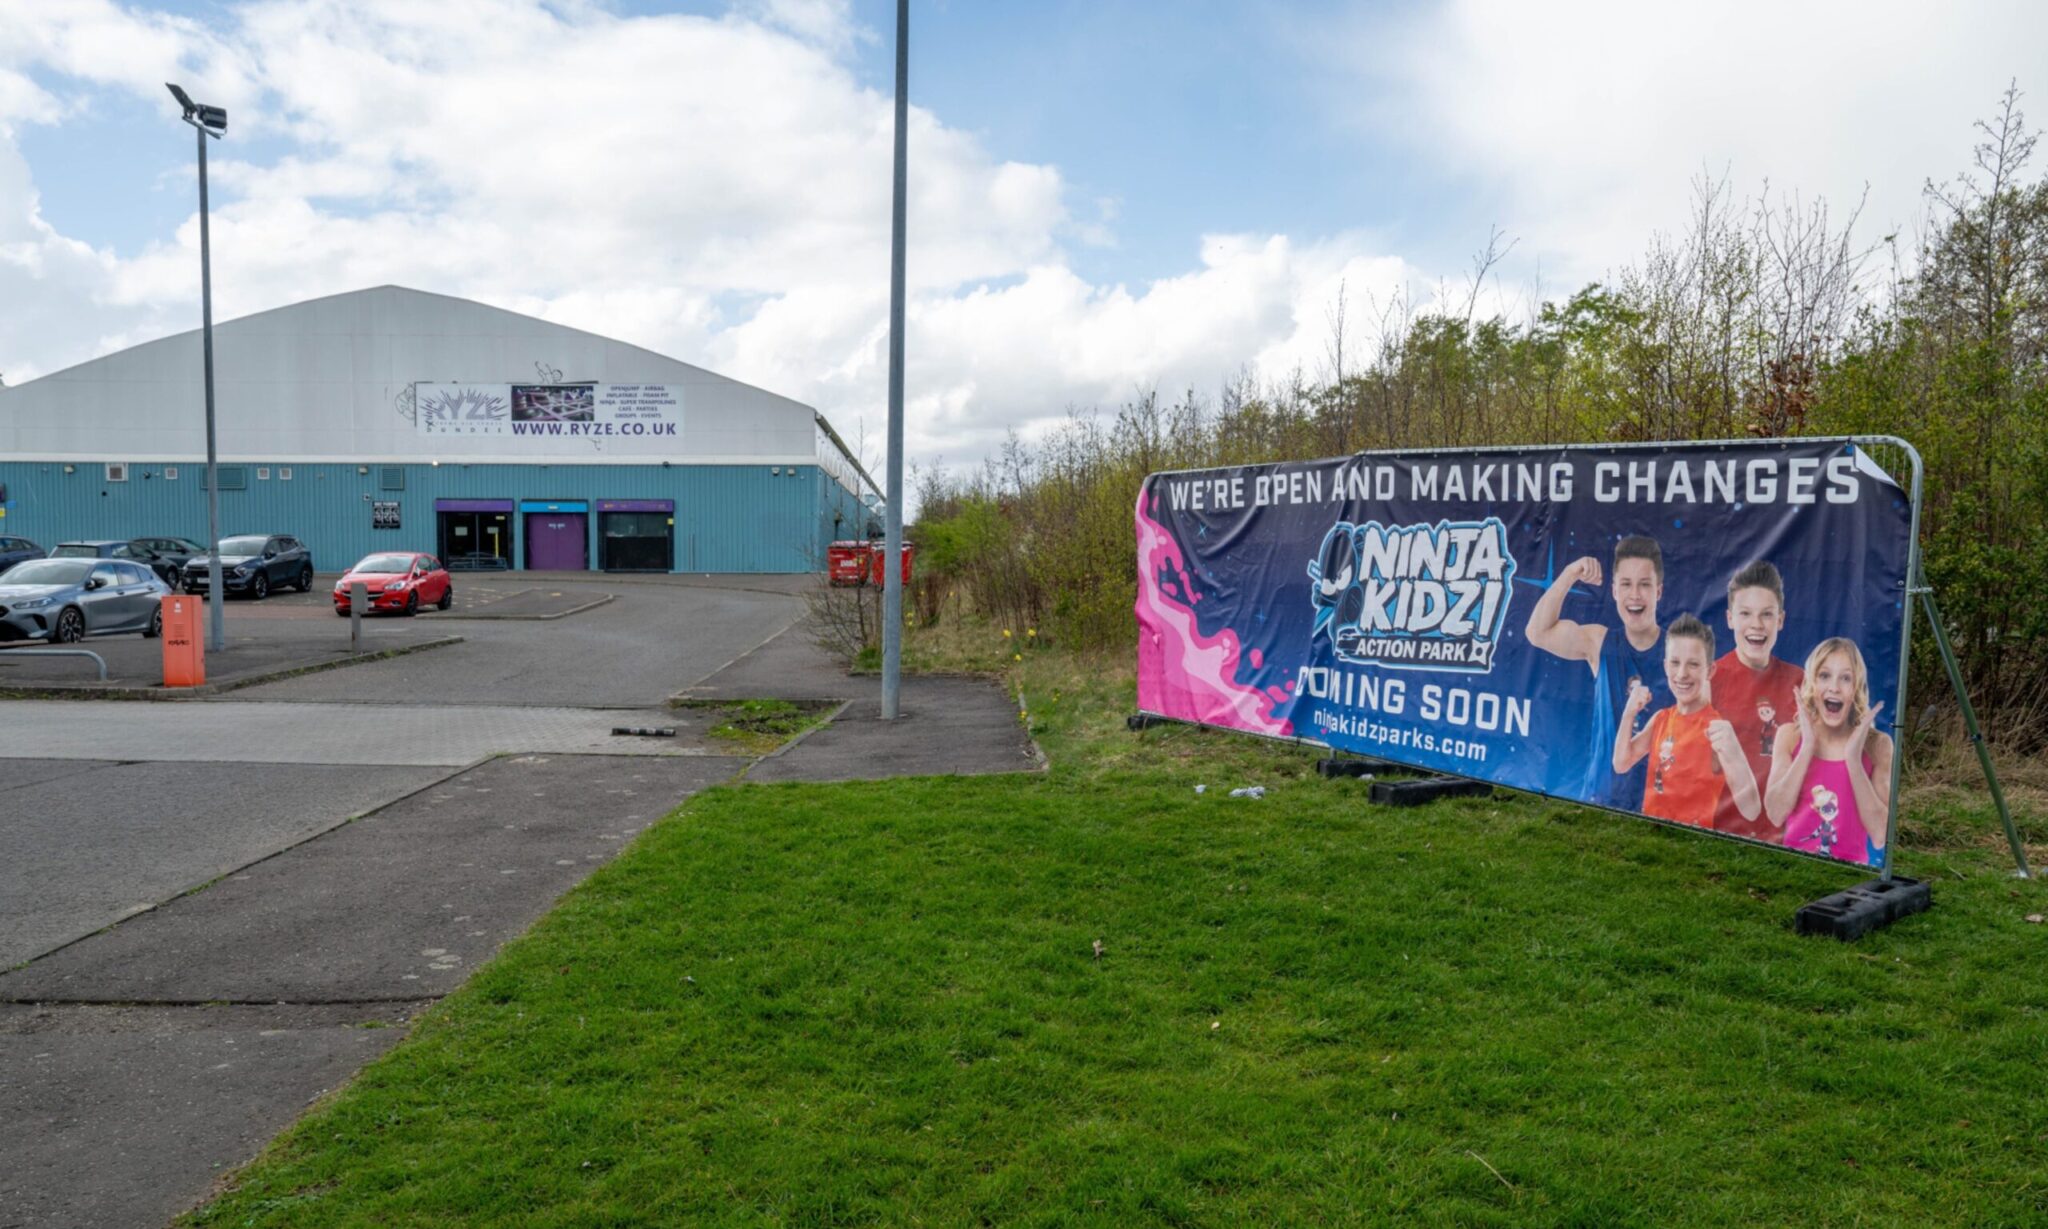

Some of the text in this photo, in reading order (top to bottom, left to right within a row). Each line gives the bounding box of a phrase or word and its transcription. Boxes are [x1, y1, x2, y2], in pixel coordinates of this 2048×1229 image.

[512, 422, 677, 435] WWW.RYZE.CO.UK
[1170, 457, 1859, 510] WE'RE OPEN AND MAKING CHANGES
[1359, 525, 1506, 581] NINJA
[1355, 638, 1468, 662] ACTION PARK
[1314, 707, 1486, 761] ninakidzparks.com
[1420, 684, 1531, 737] SOON
